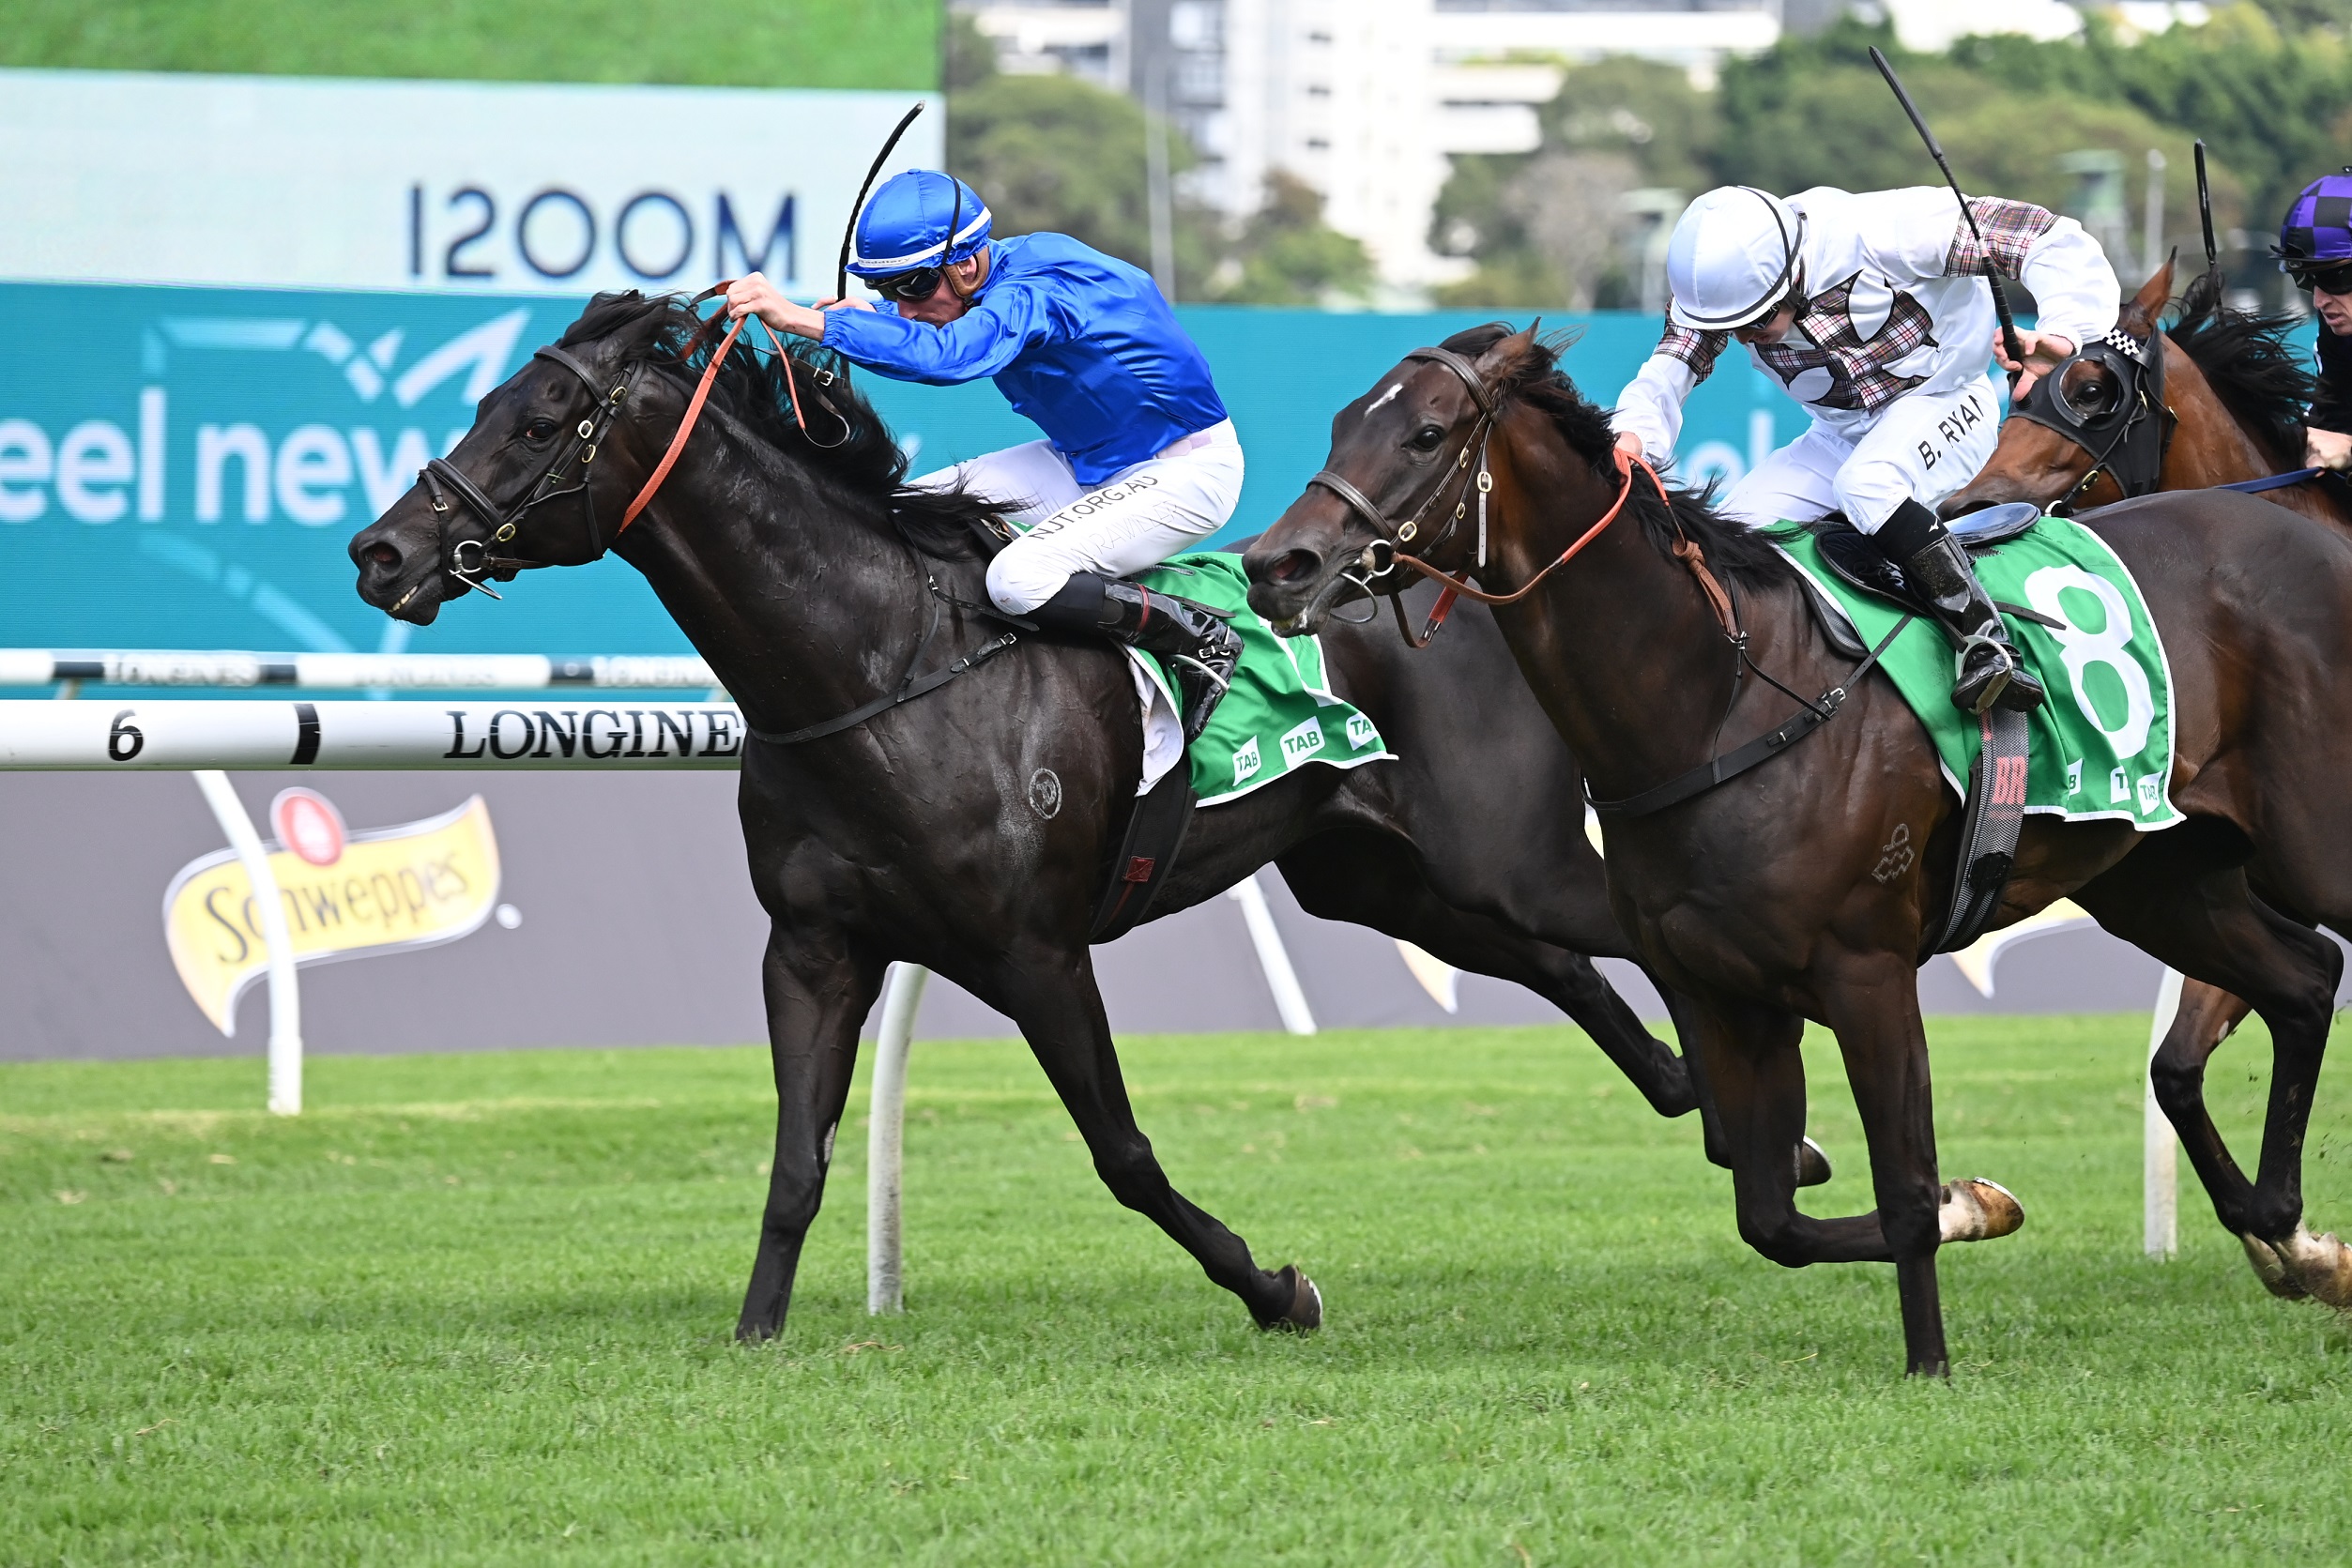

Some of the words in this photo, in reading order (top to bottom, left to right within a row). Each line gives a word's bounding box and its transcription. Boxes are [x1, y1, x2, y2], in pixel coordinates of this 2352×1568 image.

[410, 182, 797, 280] 1200M
[1917, 440, 1942, 470] B.
[1028, 476, 1158, 540] NJT.ORG.AU
[2024, 564, 2156, 759] 8
[108, 710, 144, 761] 6
[444, 710, 746, 760] LONGINE
[1285, 731, 1321, 754] TAB
[1351, 720, 1378, 737] TA
[1236, 752, 1258, 771] TAB
